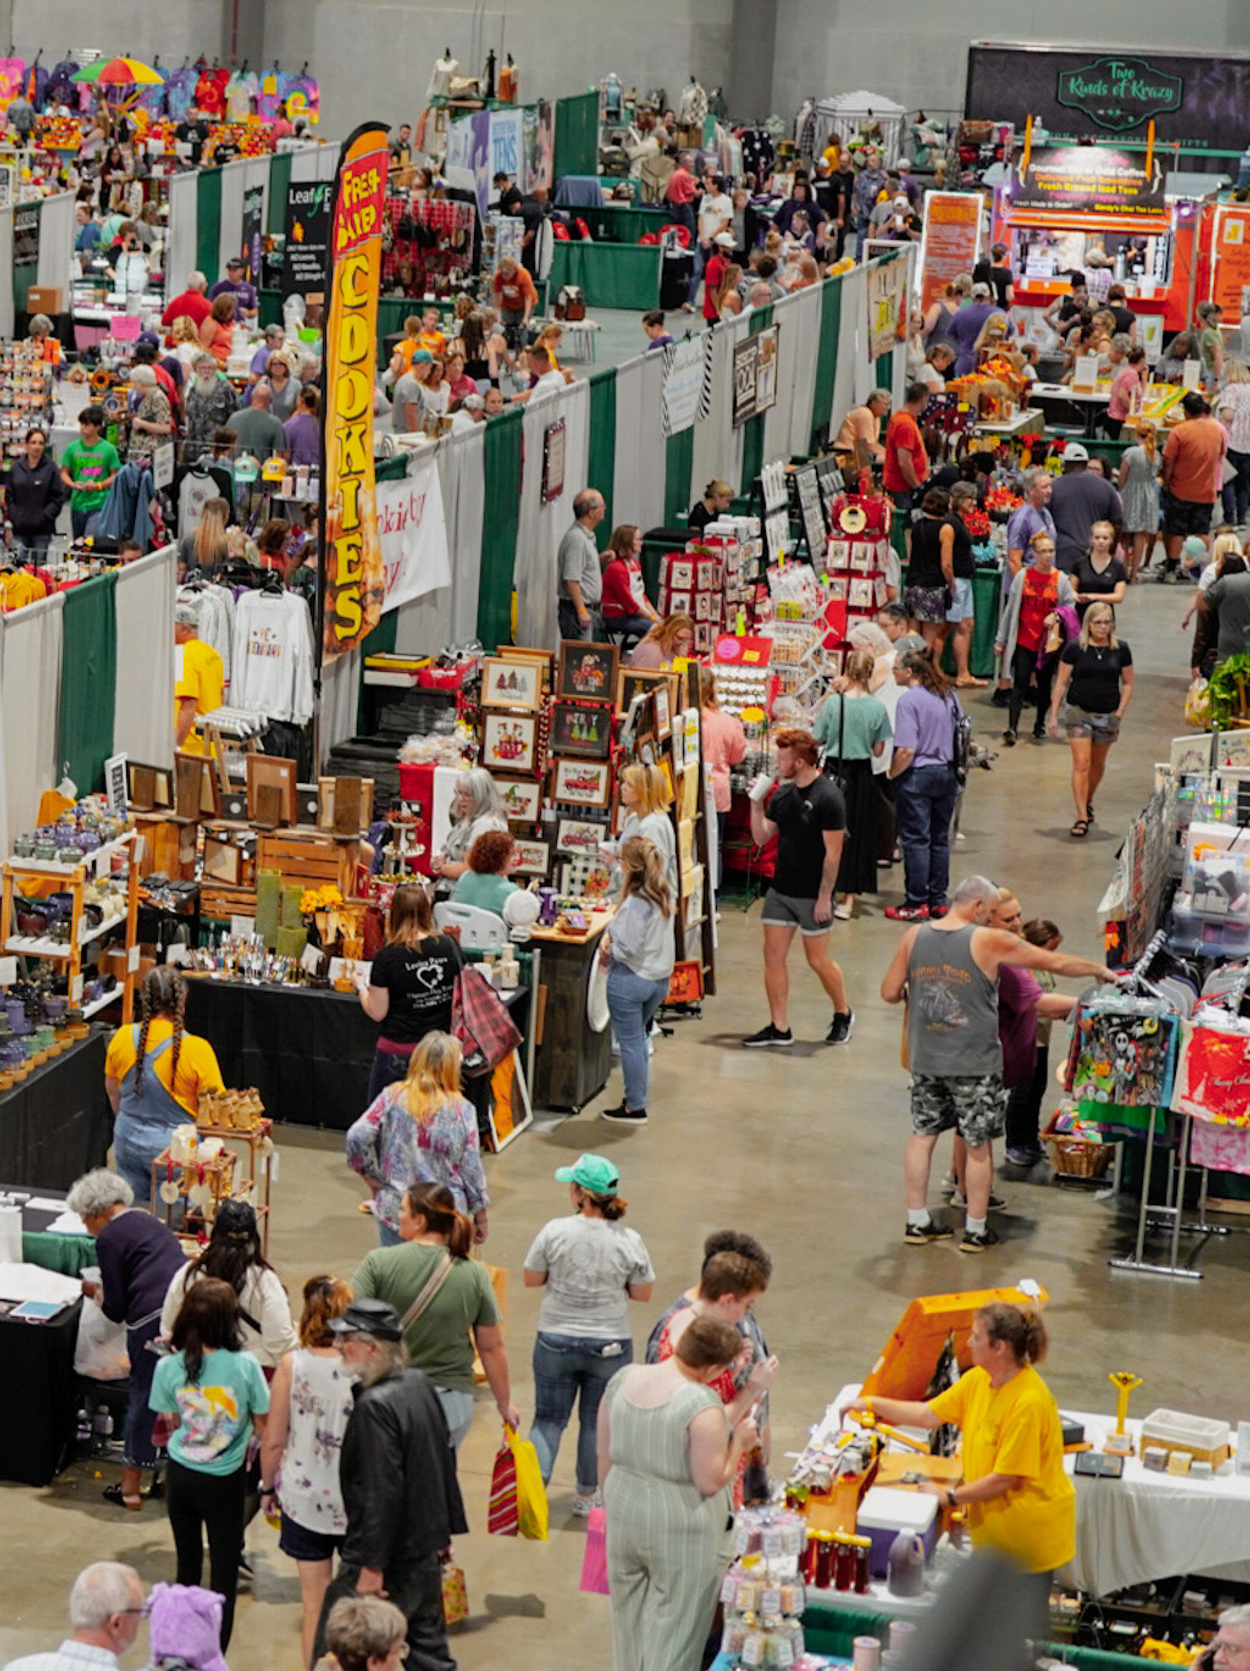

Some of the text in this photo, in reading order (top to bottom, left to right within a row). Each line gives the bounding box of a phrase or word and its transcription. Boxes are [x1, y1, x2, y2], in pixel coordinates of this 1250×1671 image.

[1107, 61, 1136, 80] Two
[1068, 76, 1175, 101] Kinds of Krazy
[289, 187, 316, 204] Leaf
[333, 253, 370, 642] COOKIES
